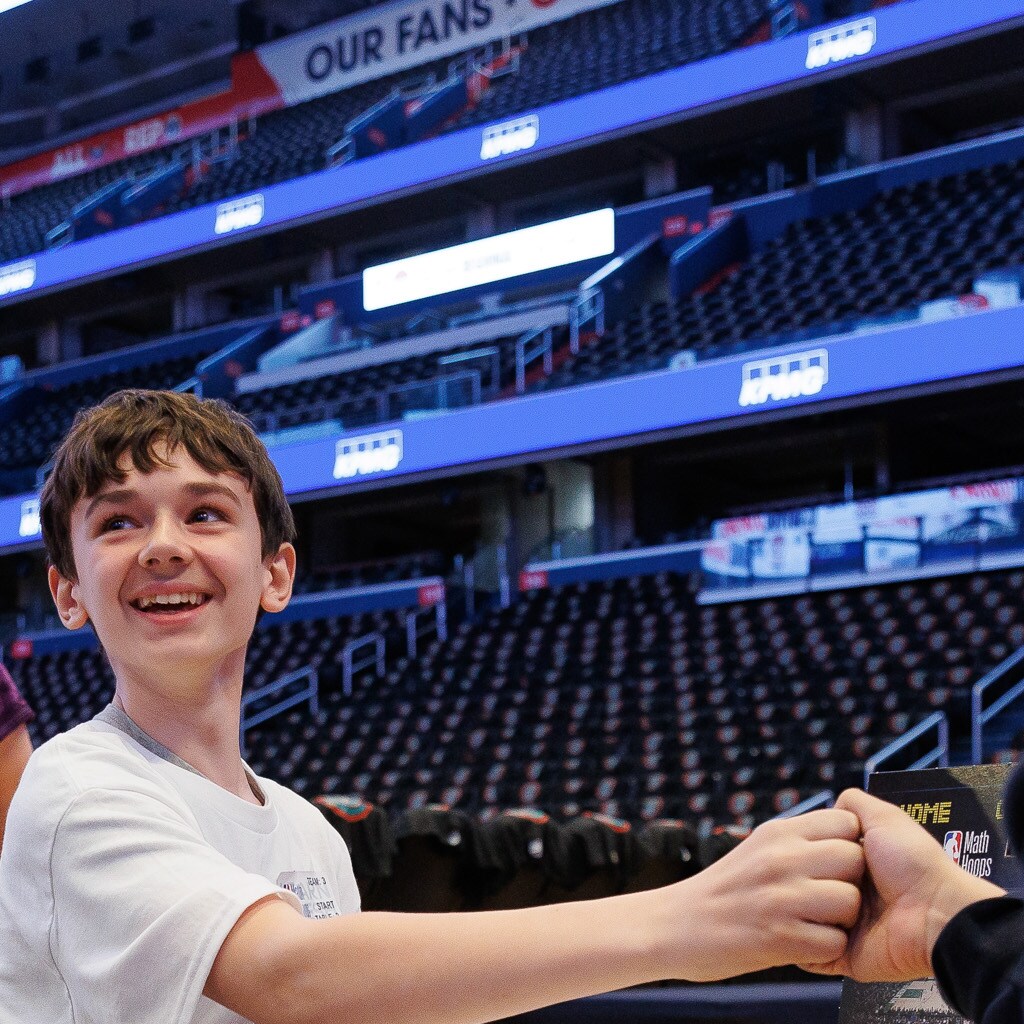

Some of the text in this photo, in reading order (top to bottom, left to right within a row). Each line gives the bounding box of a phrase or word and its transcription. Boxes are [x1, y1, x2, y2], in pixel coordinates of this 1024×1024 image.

[306, 0, 493, 82] OUR FANS
[963, 829, 990, 854] Math
[321, 876, 327, 885] 3
[316, 900, 335, 911] START
